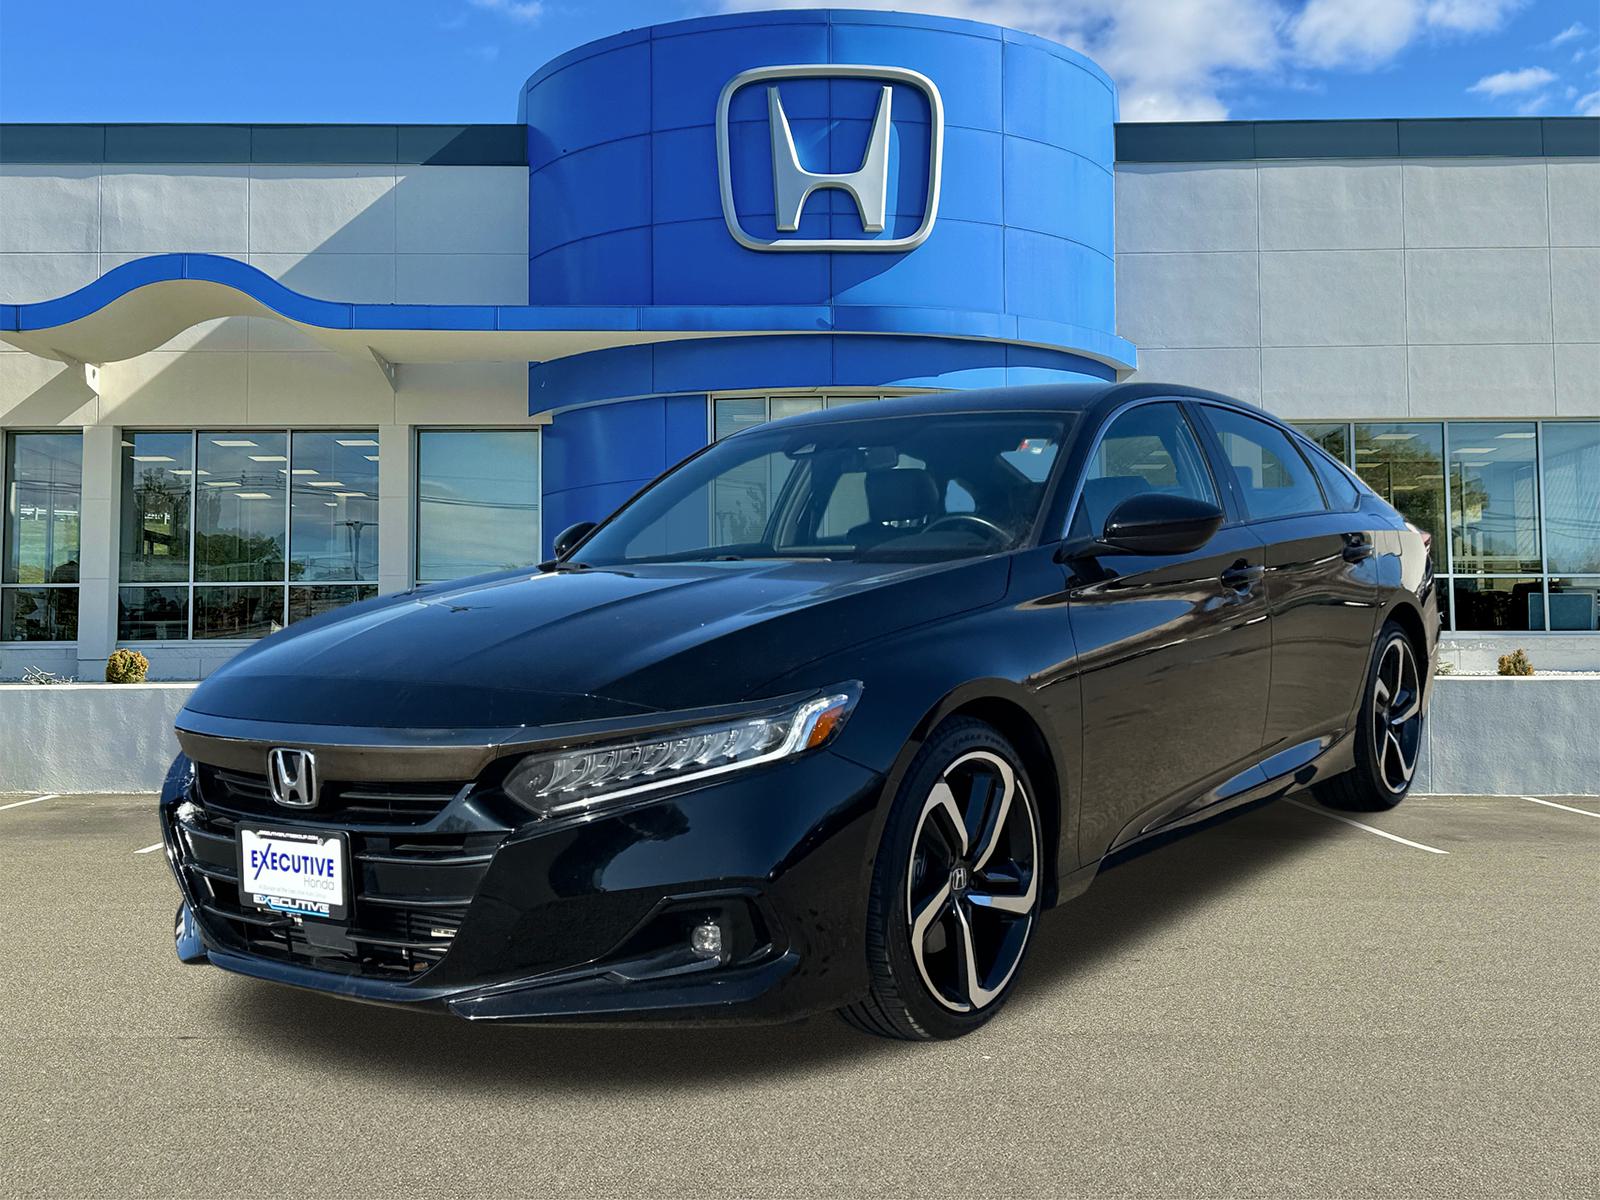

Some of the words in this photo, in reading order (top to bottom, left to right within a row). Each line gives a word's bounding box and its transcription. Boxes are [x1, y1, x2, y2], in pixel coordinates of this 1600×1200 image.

[251, 843, 334, 880] EXECUTIVE
[304, 877, 334, 891] Honda
[253, 894, 330, 915] EXECUTIVE
